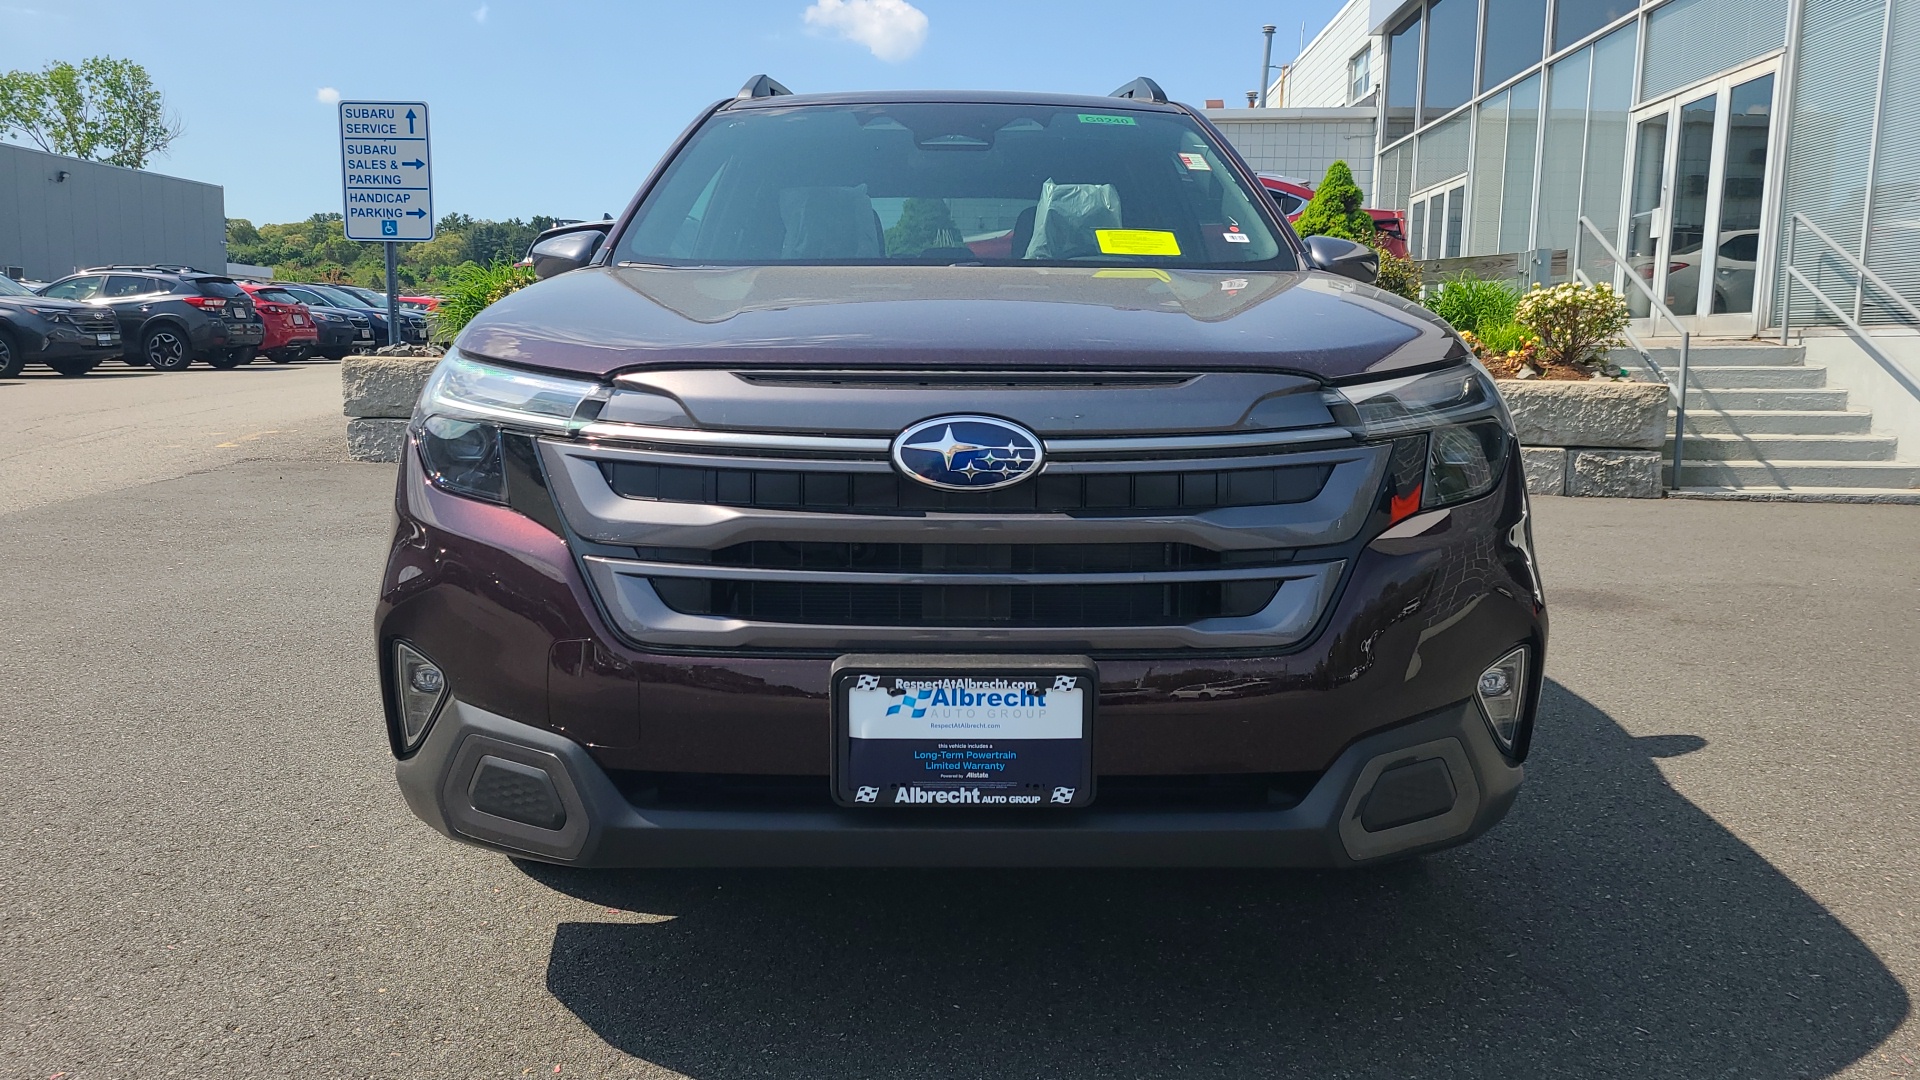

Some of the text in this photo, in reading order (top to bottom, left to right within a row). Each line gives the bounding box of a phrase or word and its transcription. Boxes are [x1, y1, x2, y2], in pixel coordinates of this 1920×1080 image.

[345, 108, 395, 119] SUBARU
[346, 123, 397, 134] SERVICE
[347, 144, 397, 155] SUBARU
[348, 159, 399, 170] SALES &
[349, 174, 402, 185] PARKING
[349, 193, 411, 203] HANDICAP
[350, 207, 403, 218] PARKING
[895, 678, 1037, 691] RespectAtAlbrecht.com
[931, 688, 1046, 707] Albrecht
[930, 709, 1047, 719] AUTO GROUP
[914, 751, 1017, 760] Long-Term Powertrain
[925, 762, 1006, 771] Limited Warranty
[894, 787, 1041, 804] Albrecht AUTO GROUP
